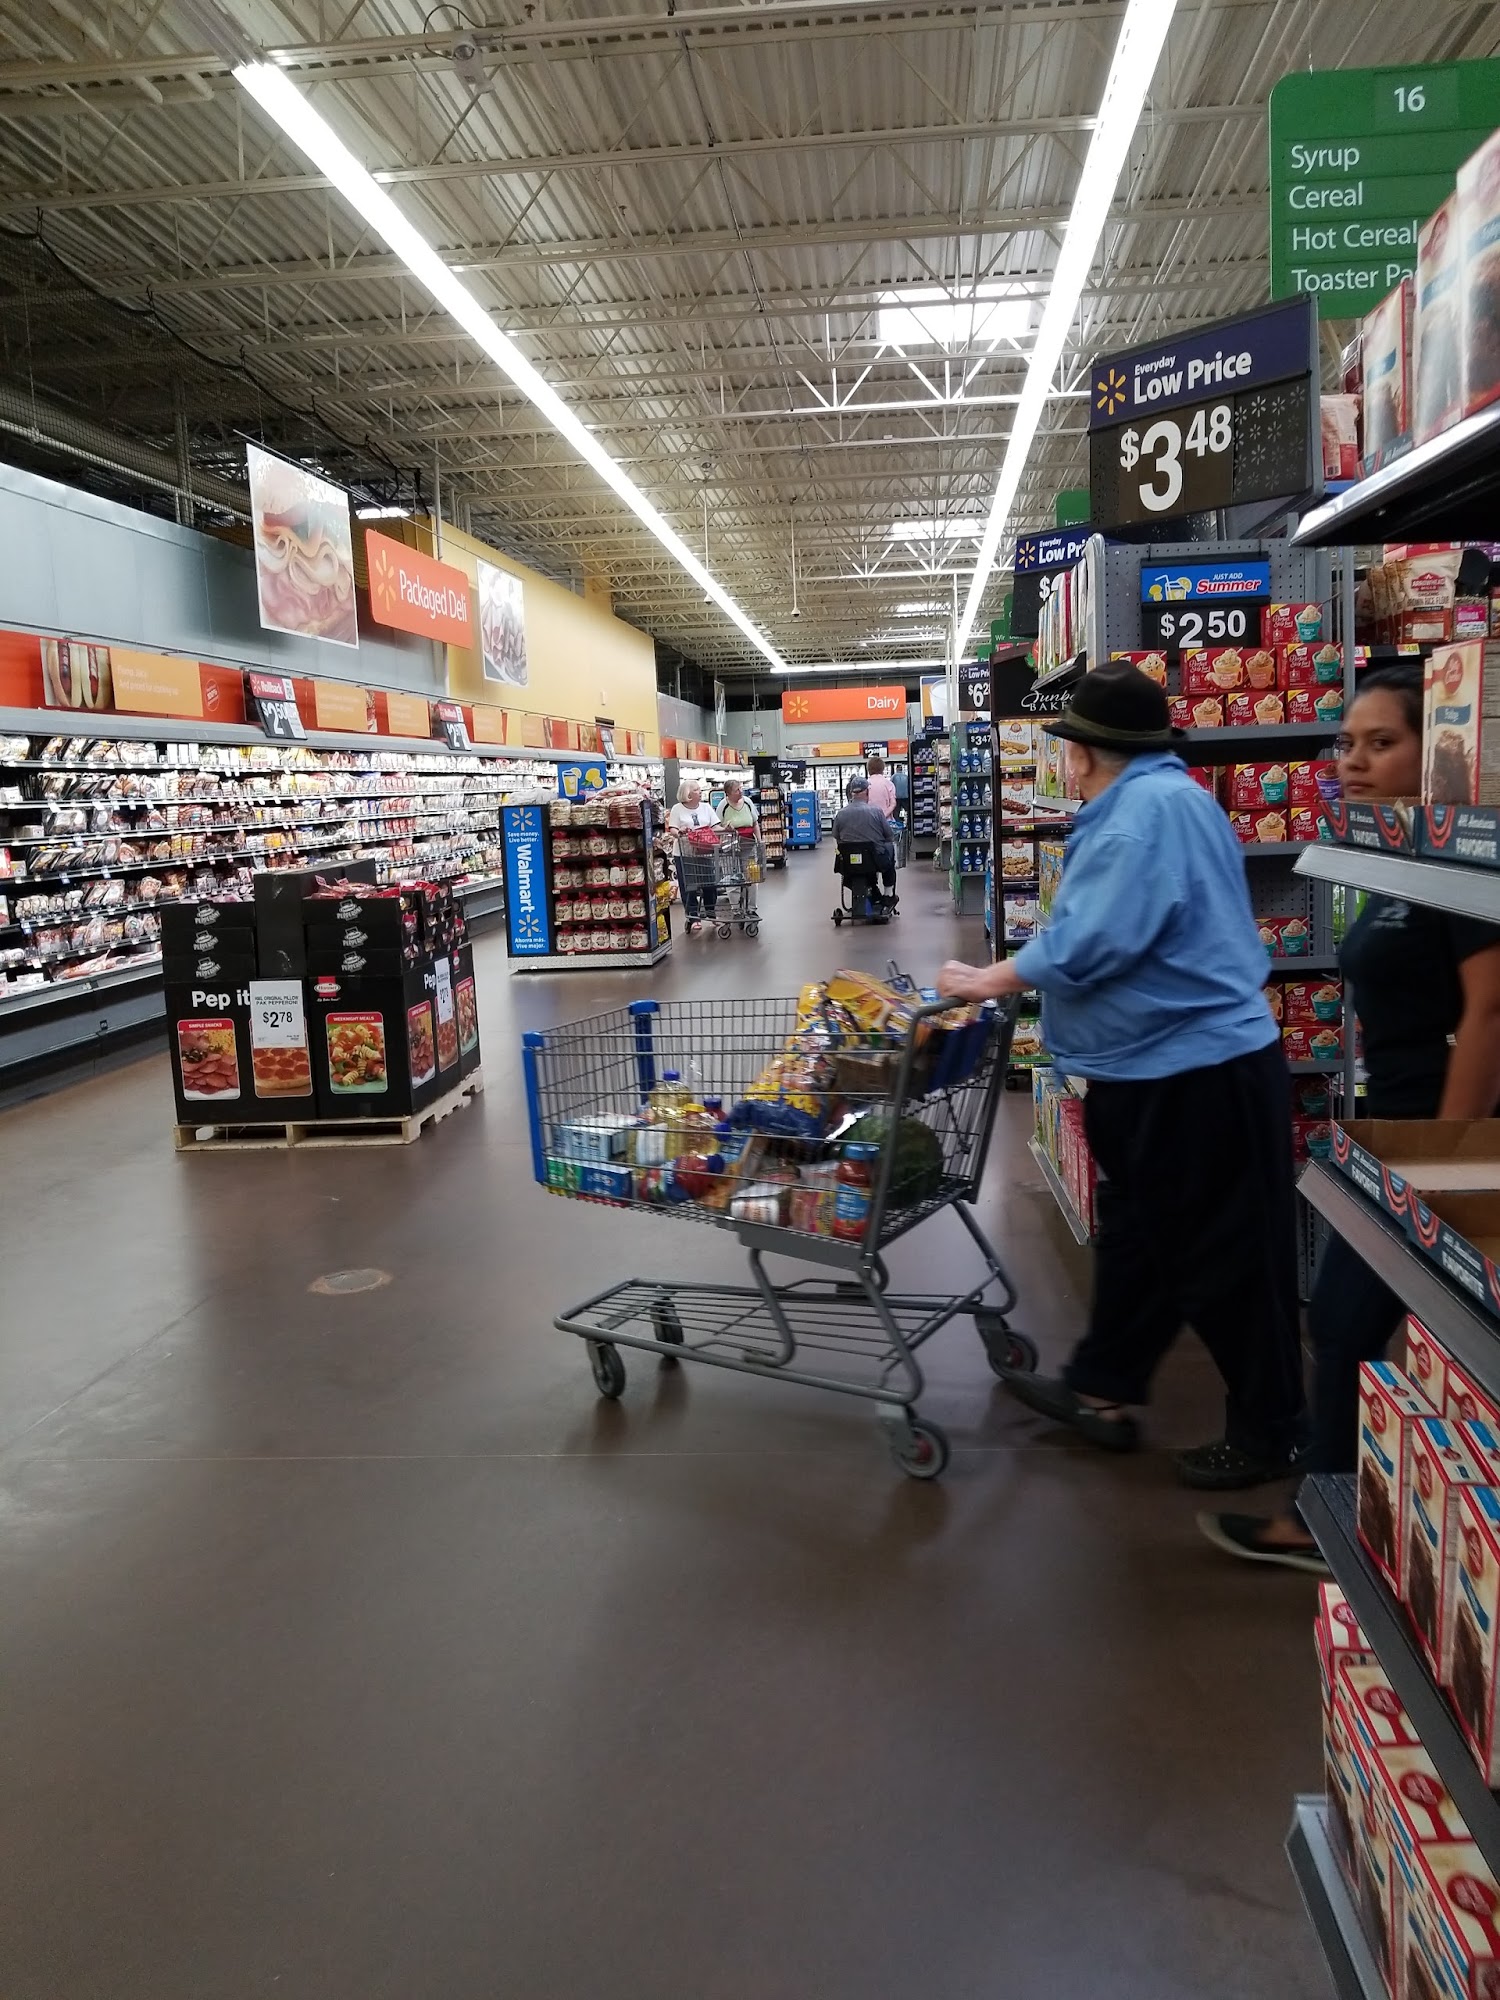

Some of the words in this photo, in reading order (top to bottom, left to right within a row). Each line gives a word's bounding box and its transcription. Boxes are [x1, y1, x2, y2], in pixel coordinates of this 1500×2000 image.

[1394, 86, 1426, 112] 16
[1291, 145, 1360, 175] Syrup
[1289, 181, 1363, 209] Cereal
[1293, 227, 1336, 251] Hot
[1344, 220, 1418, 248] Cereal
[1291, 268, 1379, 293] Toaster
[1134, 371, 1183, 405] Low
[1188, 351, 1252, 390] Price
[1135, 356, 1176, 376] Everyday
[1039, 547, 1066, 564] Low
[1067, 539, 1086, 559] Pri
[1040, 538, 1062, 548] Everyday
[1196, 578, 1261, 594] Summer
[1213, 573, 1228, 581] JUST
[1229, 572, 1243, 580] ADD
[399, 569, 448, 619] Packaged
[448, 590, 468, 623] Deli
[968, 671, 980, 680] Low
[980, 669, 990, 678] Pri
[261, 681, 283, 694] Rollback
[867, 697, 899, 711] Dairy
[517, 843, 535, 913] Walmart
[192, 990, 231, 1010] Pep
